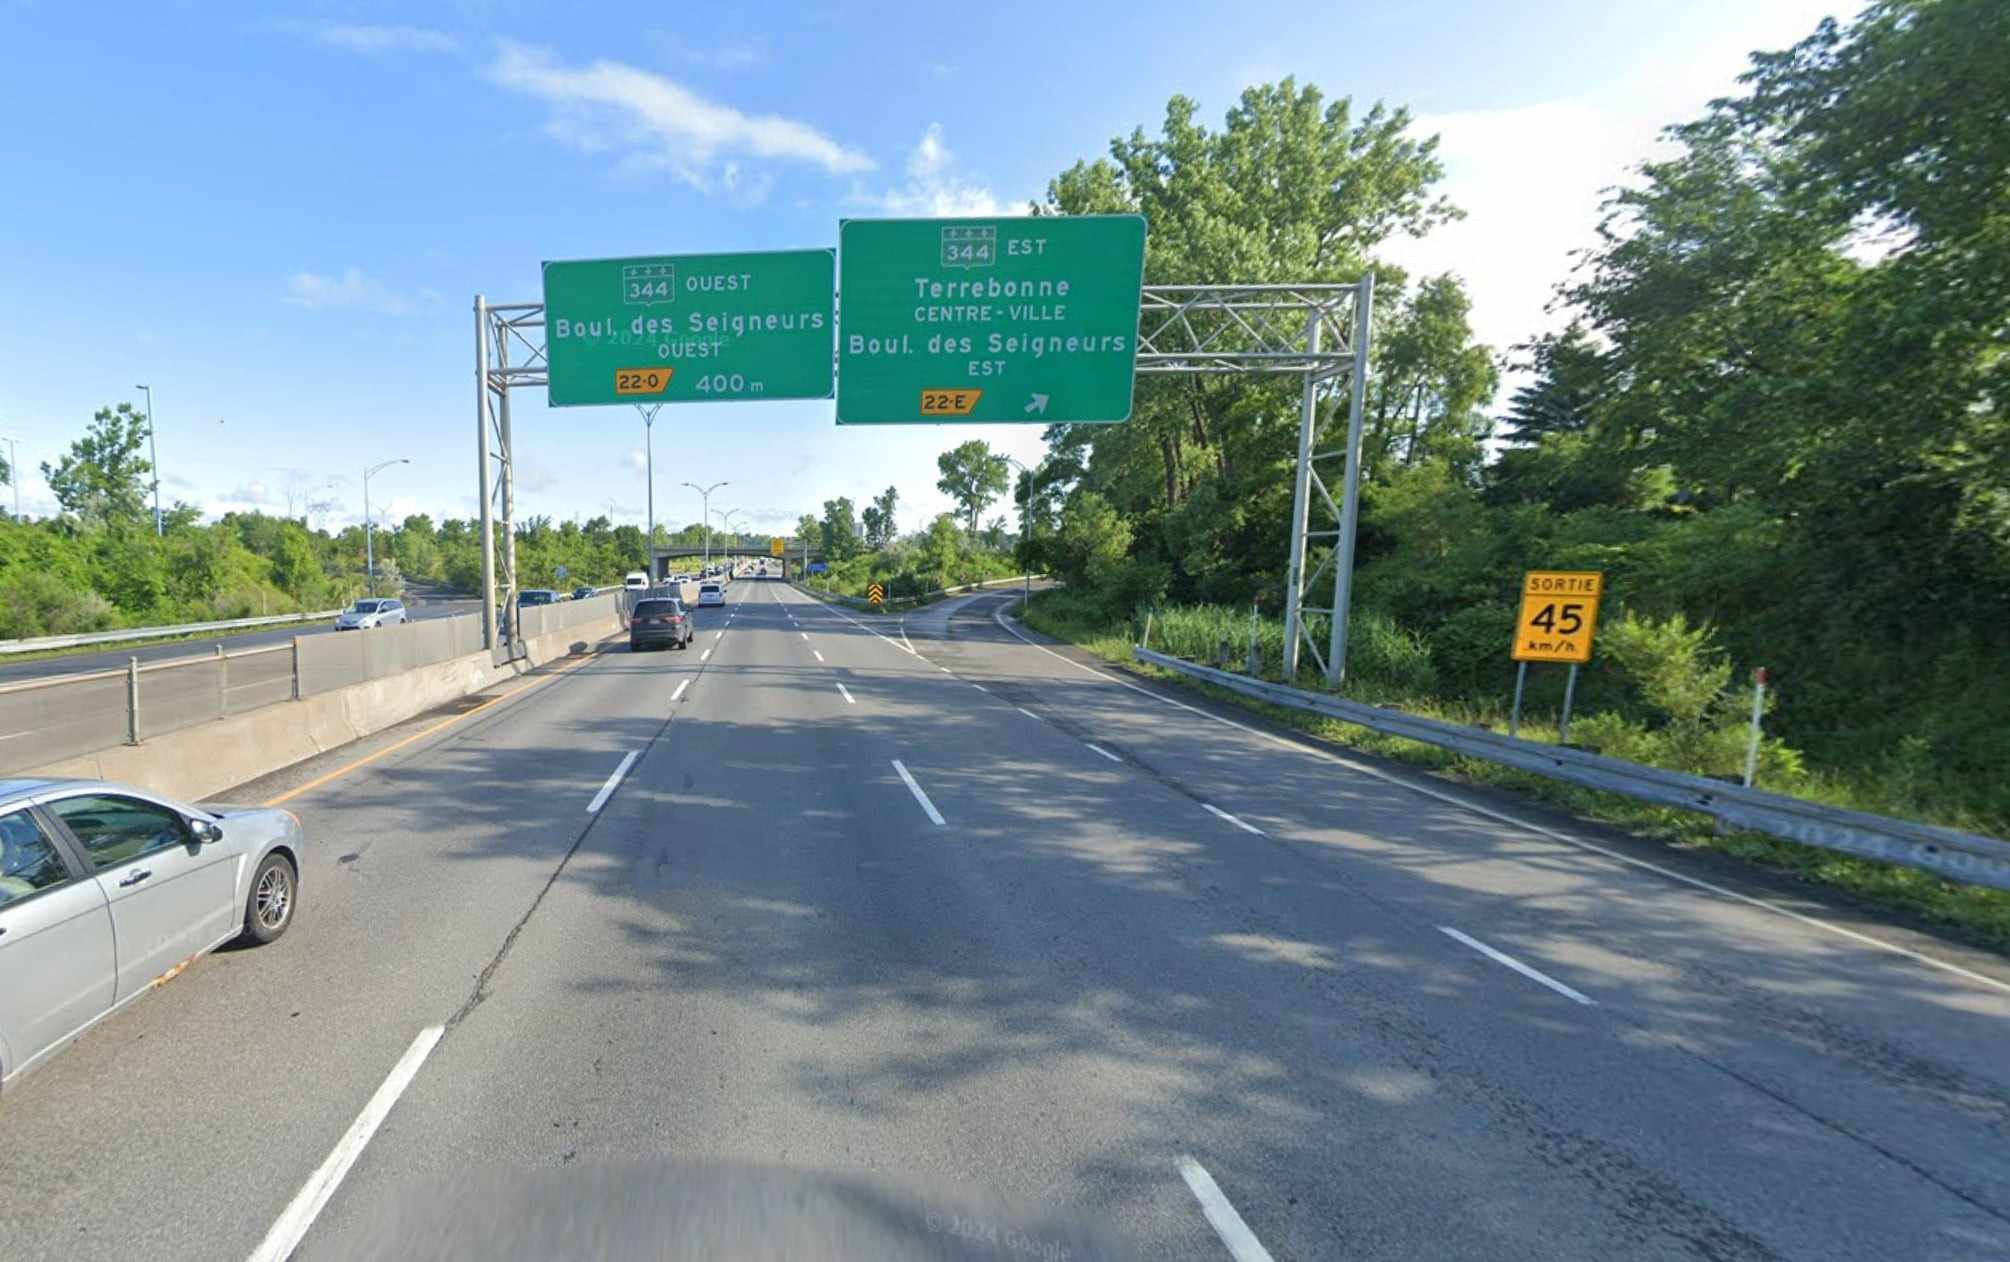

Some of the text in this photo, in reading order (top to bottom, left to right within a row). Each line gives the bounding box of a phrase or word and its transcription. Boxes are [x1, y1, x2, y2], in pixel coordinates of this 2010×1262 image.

[947, 244, 989, 261] 344
[1007, 239, 1047, 255] EST
[629, 282, 669, 299] 344
[686, 274, 752, 292] OUEST
[915, 277, 1070, 298] Terrebonne
[556, 311, 824, 339] Boul. des Seigneurs
[657, 341, 721, 359] OUEST
[850, 332, 1126, 358] Boul. des Seigneurs
[968, 361, 1006, 376] EST
[696, 374, 764, 393] 400 m
[1530, 578, 1596, 592] SORTIE
[1530, 603, 1584, 635] 45
[1528, 640, 1575, 653] km/h
